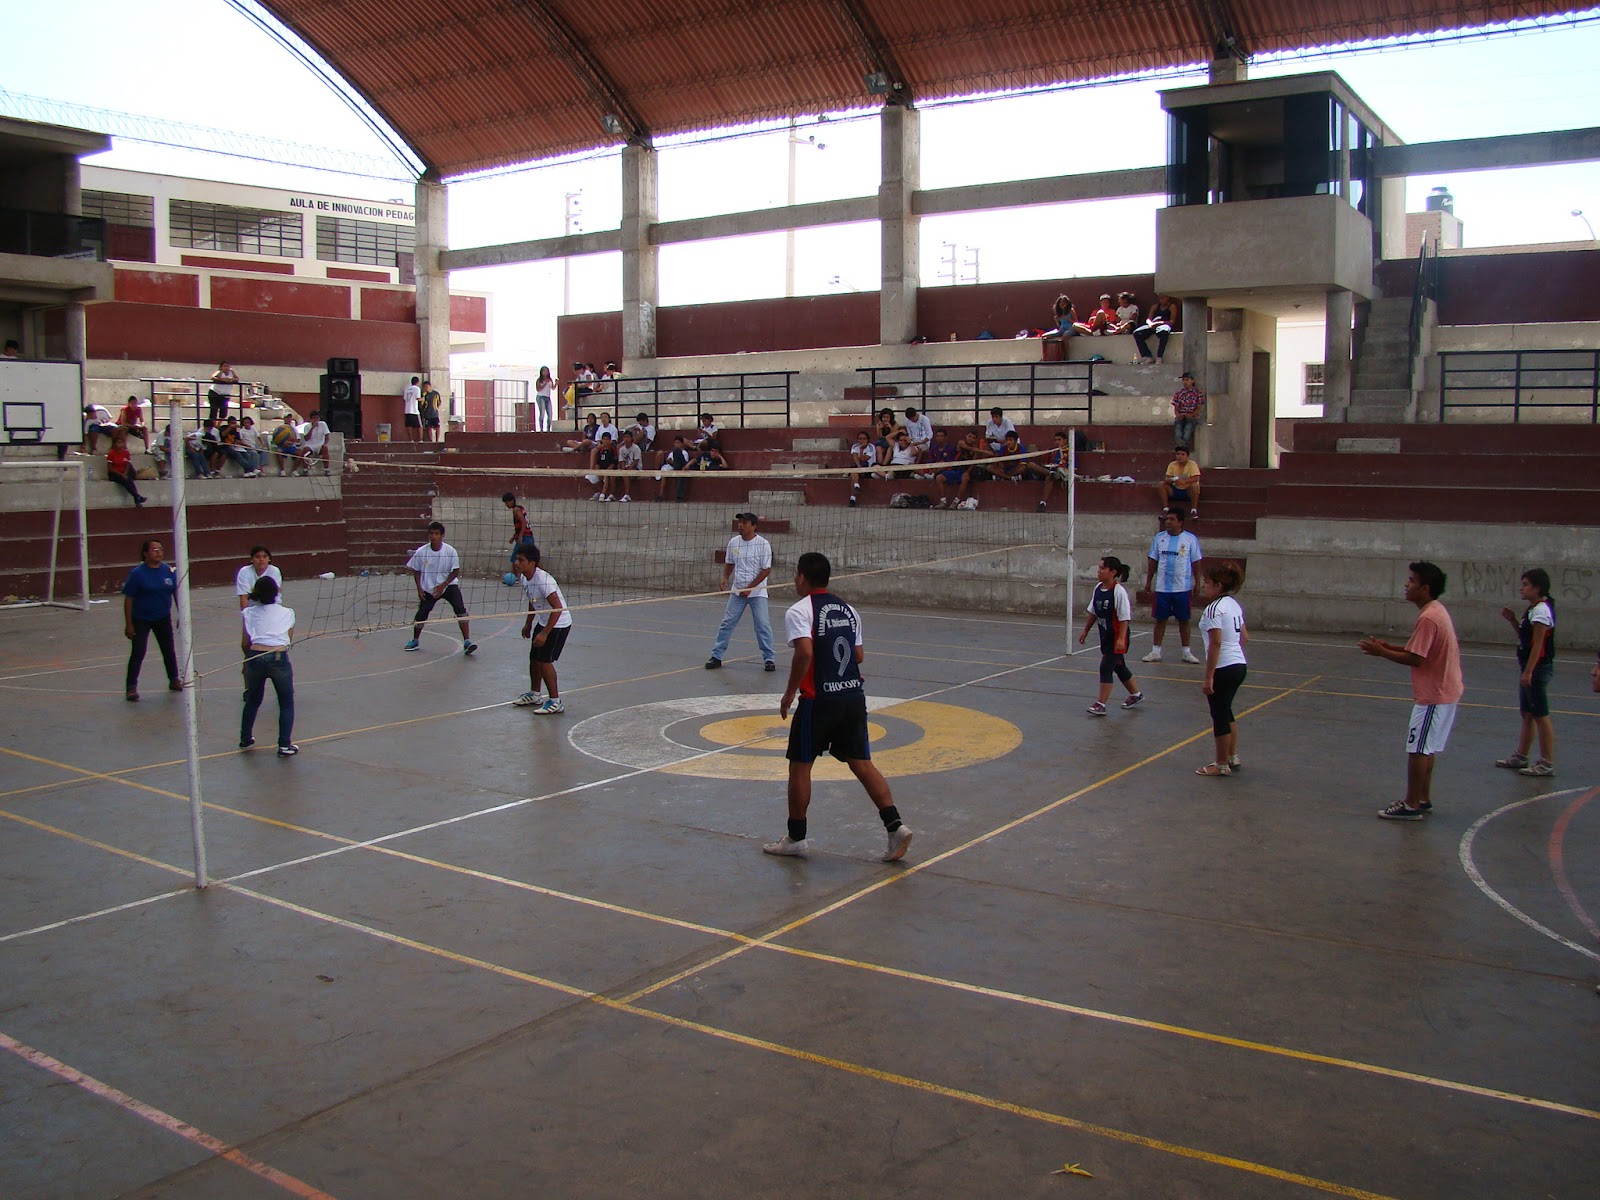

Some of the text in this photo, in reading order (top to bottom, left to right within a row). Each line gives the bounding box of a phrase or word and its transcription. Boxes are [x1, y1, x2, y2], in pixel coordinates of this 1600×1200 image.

[290, 198, 414, 220] AULA DE INNOVACION PEDAG
[833, 636, 851, 677] 9
